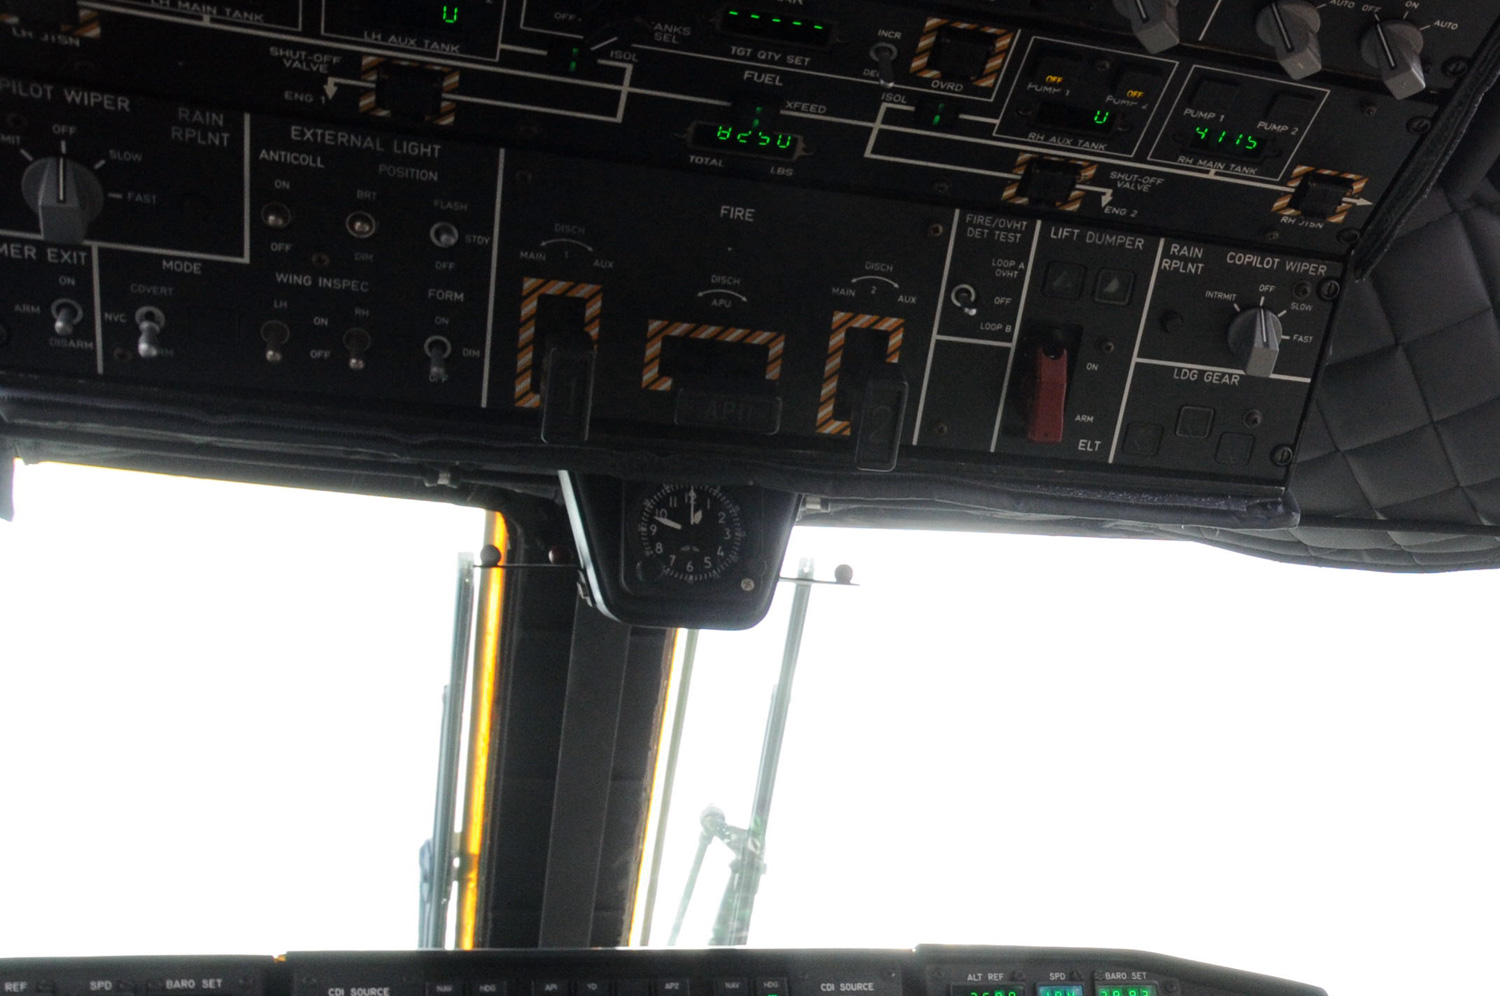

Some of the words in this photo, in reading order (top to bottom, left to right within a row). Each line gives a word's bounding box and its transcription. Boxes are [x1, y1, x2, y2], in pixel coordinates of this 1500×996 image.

[1361, 4, 1382, 13] OFF
[1433, 20, 1458, 30] AUTO
[388, 35, 418, 47] AUX
[423, 40, 460, 54] TANK
[654, 33, 680, 44] SEL
[269, 47, 342, 65] SHUT-OFF
[786, 55, 811, 67] SET
[283, 59, 329, 74] VALVE
[744, 71, 784, 86] FUEL
[931, 79, 964, 92] OVRD
[0, 78, 53, 99] PILOT
[64, 88, 130, 112] WIPER
[785, 101, 827, 114] XFEED
[178, 107, 224, 126] RAIN
[1183, 108, 1216, 120] PUMP
[52, 124, 77, 136] OFF
[1257, 121, 1289, 133] PUMP
[171, 126, 230, 147] RPLNT
[291, 126, 384, 151] EXTERNAL
[393, 140, 441, 158] LIGHT
[1049, 136, 1074, 146] AUX
[1077, 140, 1108, 151] TANK
[109, 149, 142, 163] SLOW
[259, 150, 325, 168] ANTICOLL
[689, 155, 725, 168] TOTAL
[1199, 158, 1227, 170] MAIN
[379, 165, 438, 181] POSITION
[1109, 171, 1165, 186] SHUT-OFF
[274, 180, 290, 189] ON
[1117, 180, 1151, 193] VALVE
[433, 200, 468, 211] FLASH
[1104, 205, 1129, 216] ENG
[720, 205, 755, 222] FIRE
[554, 223, 585, 235] DISCH
[966, 214, 1028, 232] FIRE/OVHT
[966, 227, 988, 239] DET
[990, 231, 1022, 243] TEST
[1050, 227, 1080, 242] LIFT
[1085, 231, 1144, 250] DUMPER
[271, 243, 292, 252] OFF
[1170, 244, 1204, 259] RAIN
[47, 248, 88, 265] EXIT
[520, 251, 546, 262] MAIN
[162, 260, 202, 274] MODE
[593, 260, 614, 269] AUX
[865, 261, 893, 272] DISCH
[991, 259, 1016, 270] LOOP
[1161, 259, 1205, 275] RPLNT
[1226, 252, 1280, 269] COPILOT
[1285, 259, 1327, 276] WIPER
[995, 269, 1018, 278] OVHT
[275, 272, 312, 286] WING
[319, 277, 369, 292] INSPEC
[711, 275, 741, 286] DISCH
[130, 283, 174, 296] COVERT
[428, 289, 464, 302] FORM
[831, 287, 855, 297] MAIN
[897, 295, 917, 304] AUX
[994, 297, 1011, 305] OFF
[1205, 291, 1236, 301] INTRMIT
[1290, 302, 1313, 311] SLOW
[314, 317, 328, 326] ON
[435, 316, 449, 325] ON
[980, 322, 1003, 332] LOOP
[1293, 334, 1313, 343] FAST
[310, 350, 331, 359] OFF
[462, 348, 480, 358] DIM
[1086, 363, 1098, 371] ON
[1173, 369, 1199, 381] LDG
[1203, 372, 1240, 386] GEAR
[1075, 414, 1094, 423] ARM
[1078, 440, 1101, 452] ELT
[967, 973, 985, 982] ALT
[987, 973, 1004, 981] REF
[1050, 972, 1066, 980] SPD
[1105, 972, 1128, 980] BARO
[1131, 971, 1147, 980] SET
[5, 982, 28, 992] REF
[90, 981, 112, 991] SPD
[166, 980, 195, 989] BARO
[202, 979, 222, 989] SET
[821, 983, 834, 991] CDI
[840, 982, 873, 991] SOURCE
[328, 988, 344, 996] CDI
[351, 988, 390, 996] SOURCE
